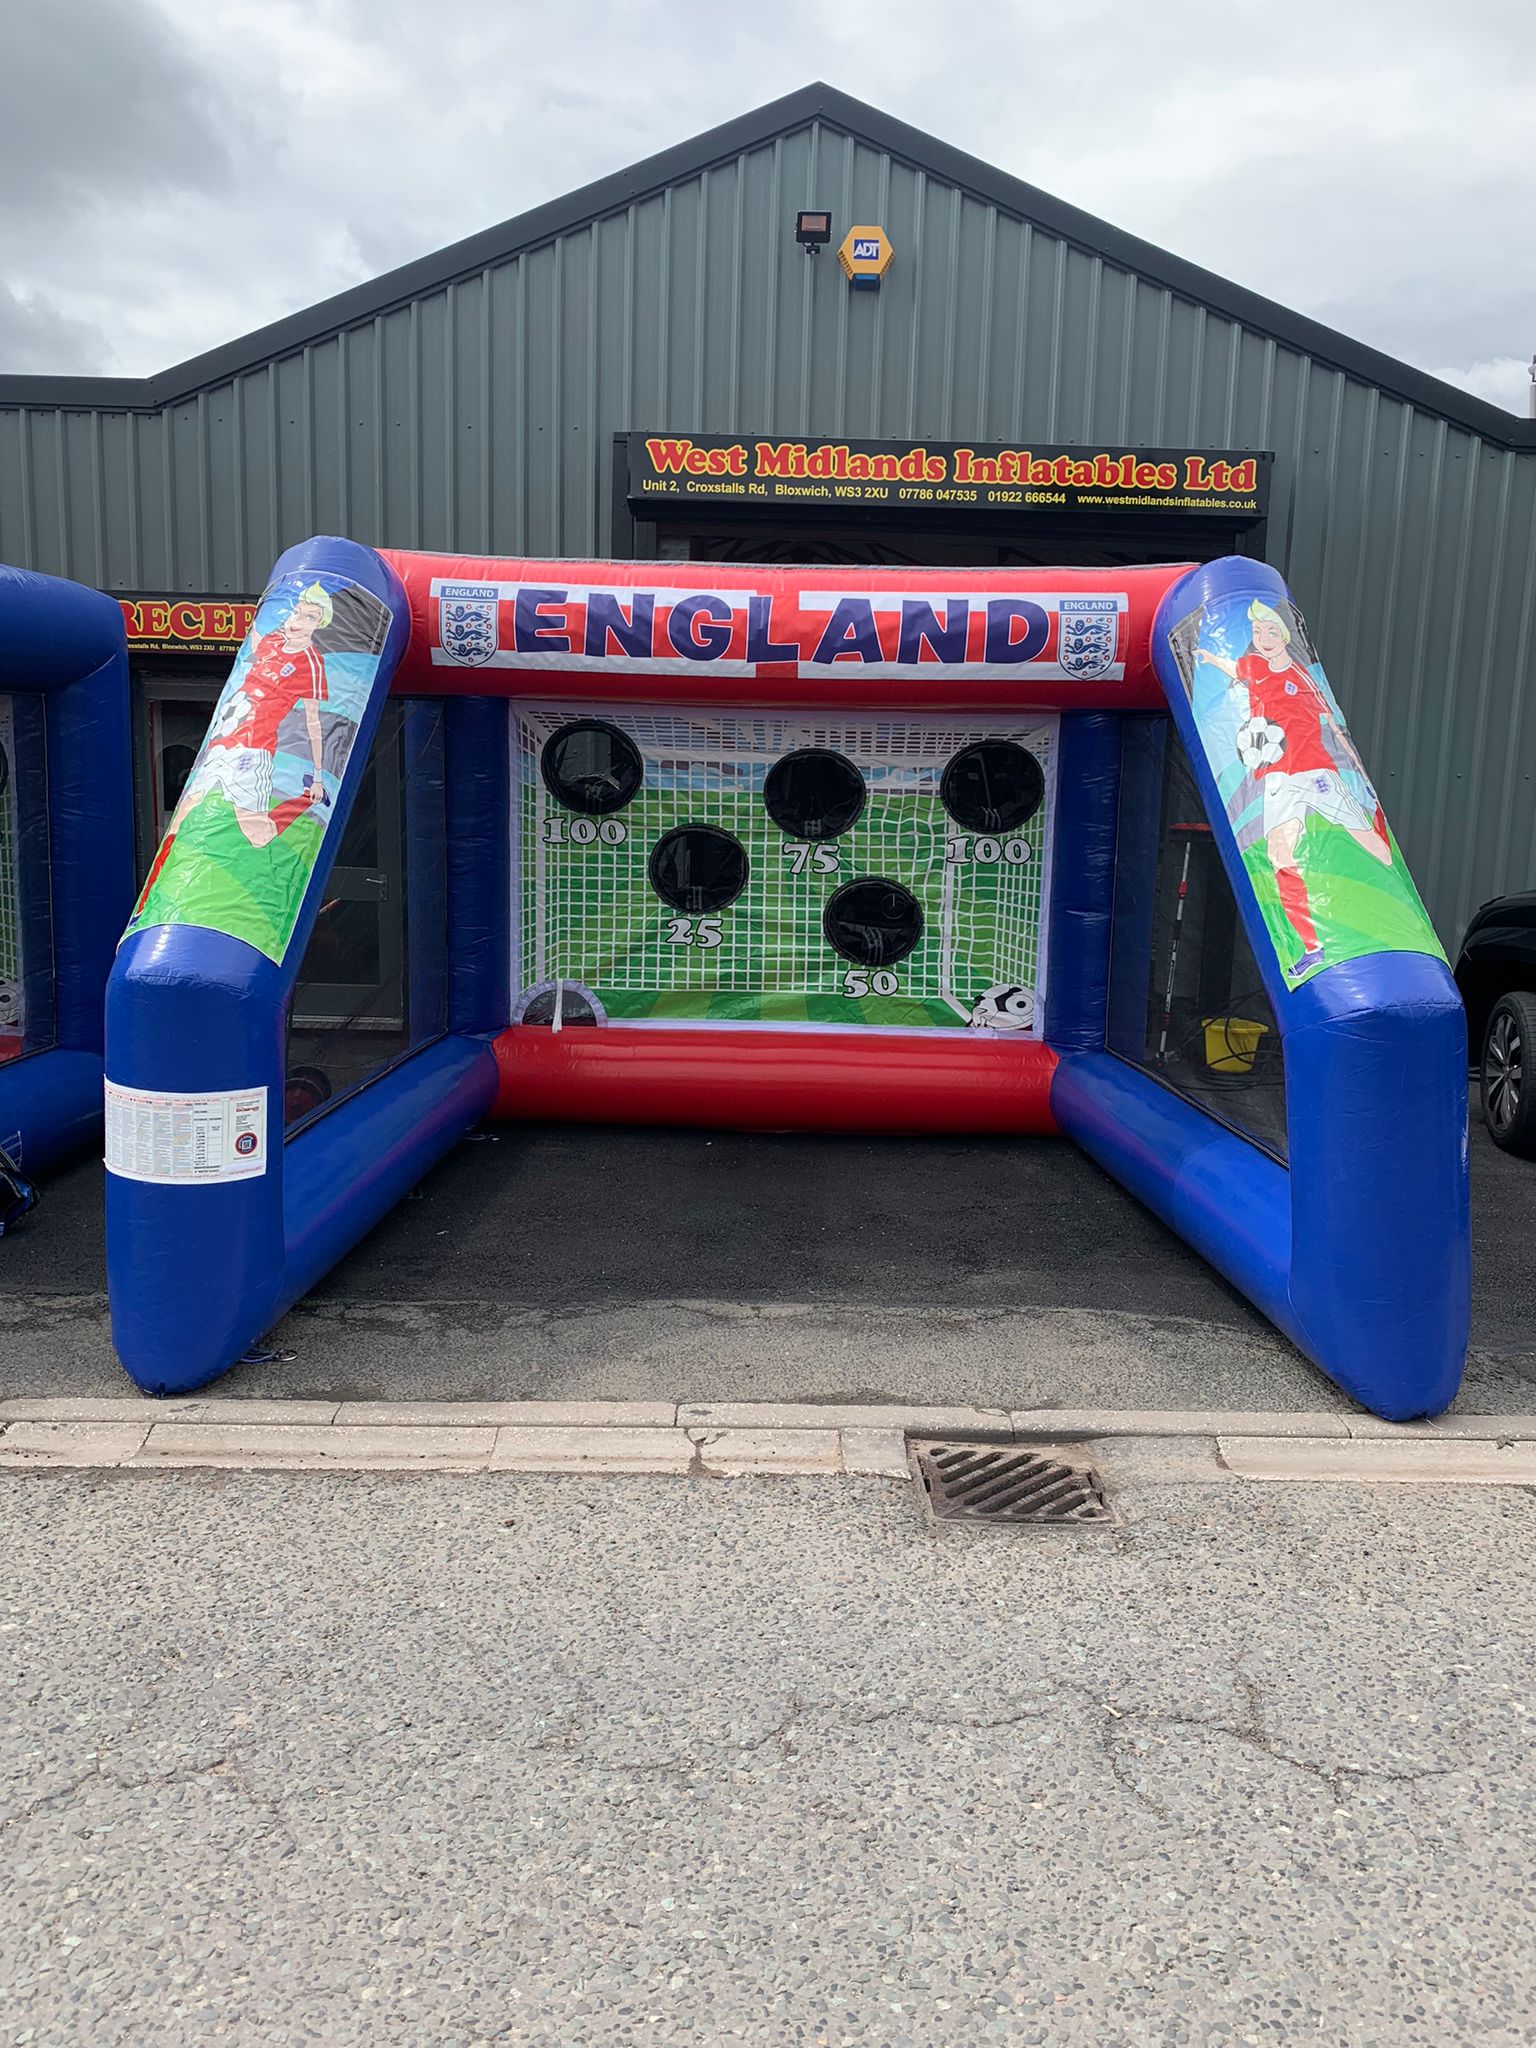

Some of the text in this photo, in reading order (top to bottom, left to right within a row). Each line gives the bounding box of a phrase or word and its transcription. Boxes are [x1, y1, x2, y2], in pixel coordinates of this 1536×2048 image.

[854, 242, 880, 257] ADT
[646, 439, 1257, 493] West Midlands Inflatables Ltd
[643, 480, 1257, 510] Unit 2, Croxstalls Rd, Bloxwich, WS3 2XU 07786 047535 01922 666544 www.westmidlandsinflatables.co.uk
[445, 587, 495, 598] ENGLAND
[1063, 601, 1114, 610] ENGLAND
[514, 588, 1050, 665] ENGLAND
[542, 817, 627, 845] 100
[783, 842, 840, 874] 75
[946, 836, 1032, 865] 100
[666, 917, 723, 948] 25
[843, 969, 899, 999] 50
